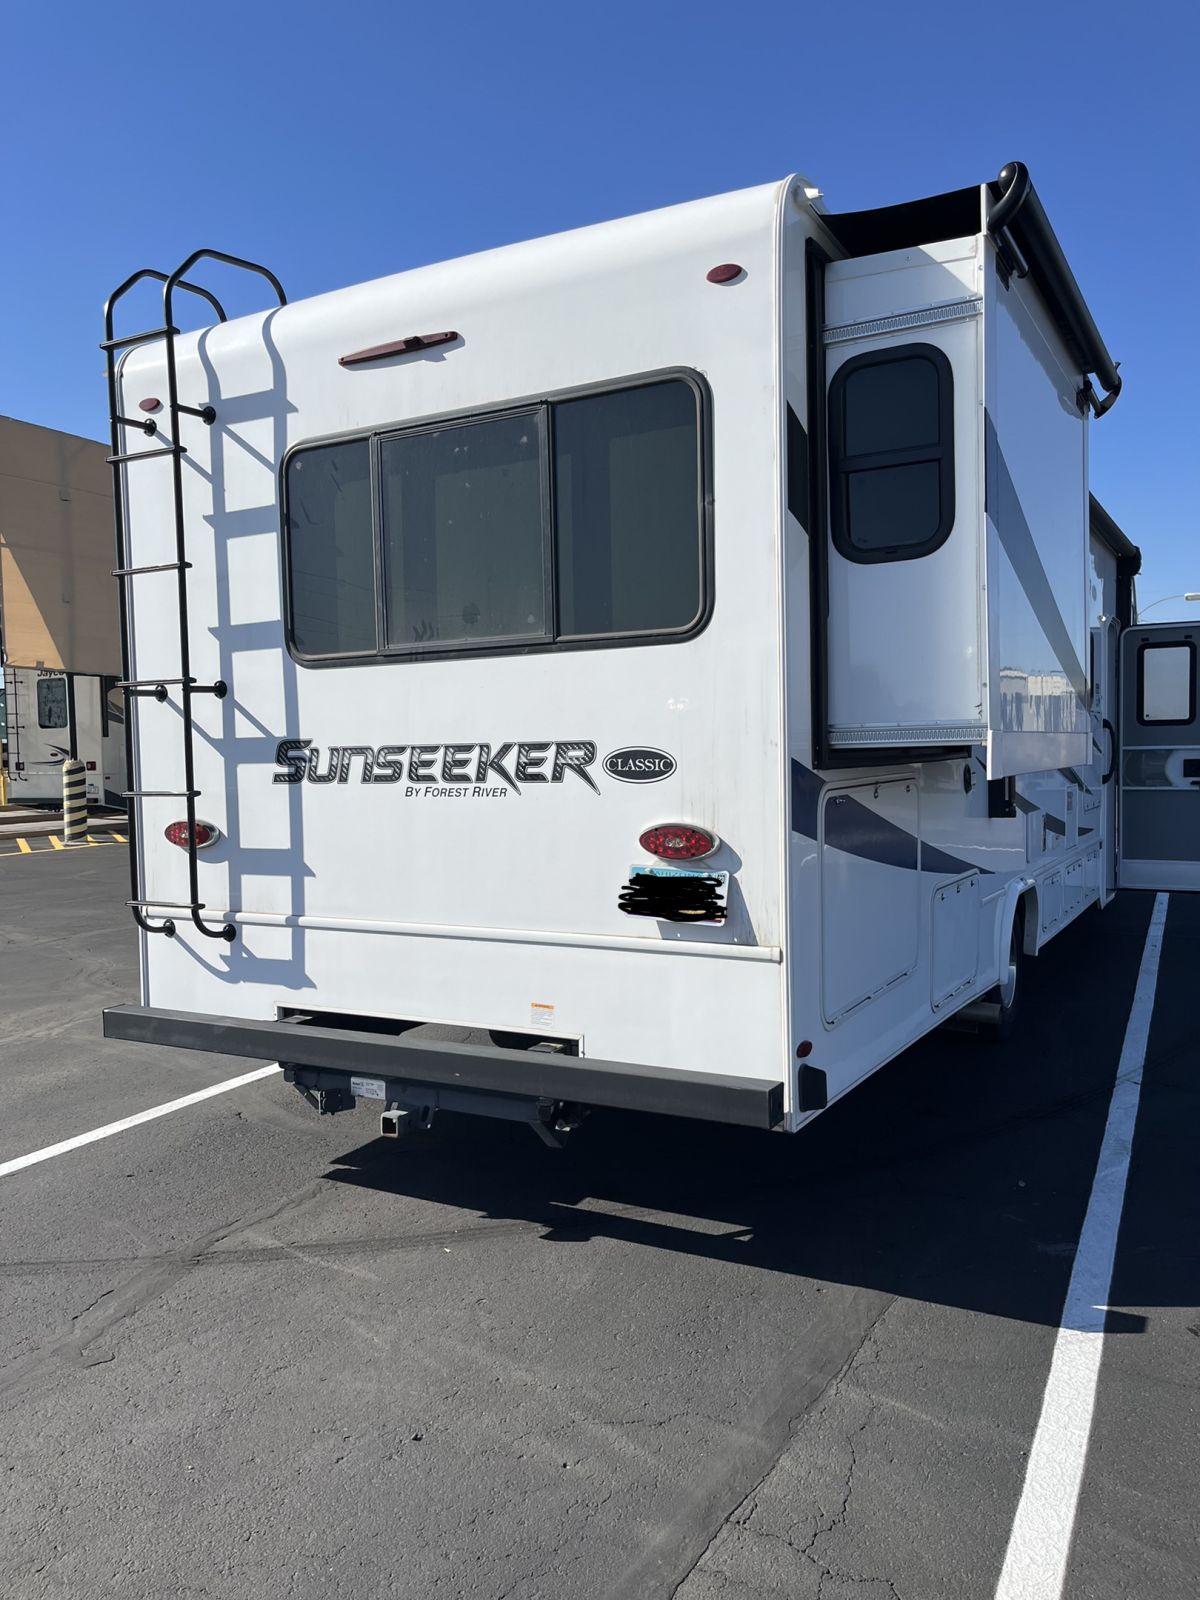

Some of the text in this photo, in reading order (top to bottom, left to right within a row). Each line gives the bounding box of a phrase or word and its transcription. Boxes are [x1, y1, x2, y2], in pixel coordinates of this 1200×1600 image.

[606, 758, 671, 771] CLASSIC
[424, 786, 469, 797] FOREST
[472, 786, 508, 797] RIVER
